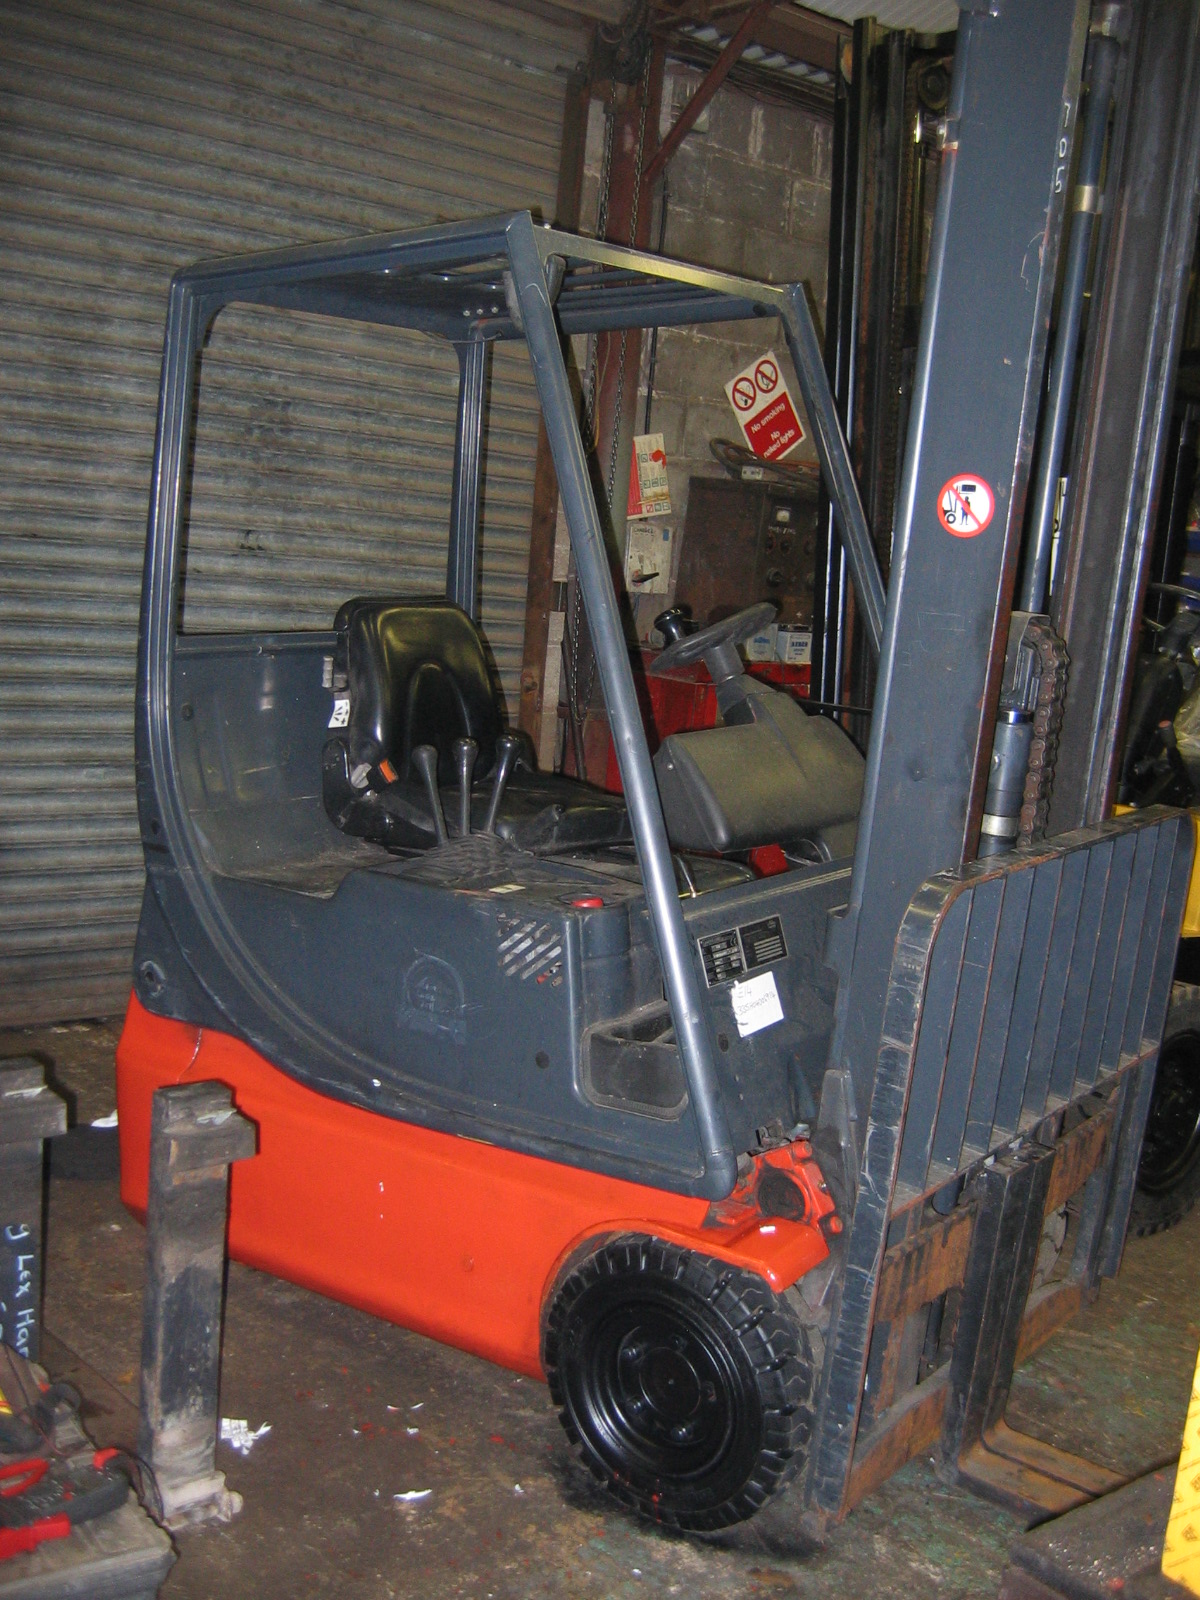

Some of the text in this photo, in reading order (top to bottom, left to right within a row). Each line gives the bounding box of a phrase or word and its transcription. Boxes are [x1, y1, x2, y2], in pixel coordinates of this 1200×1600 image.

[751, 402, 786, 434] No smoking
[771, 430, 780, 441] No
[779, 429, 795, 444] lights
[15, 1254, 34, 1298] Lex
